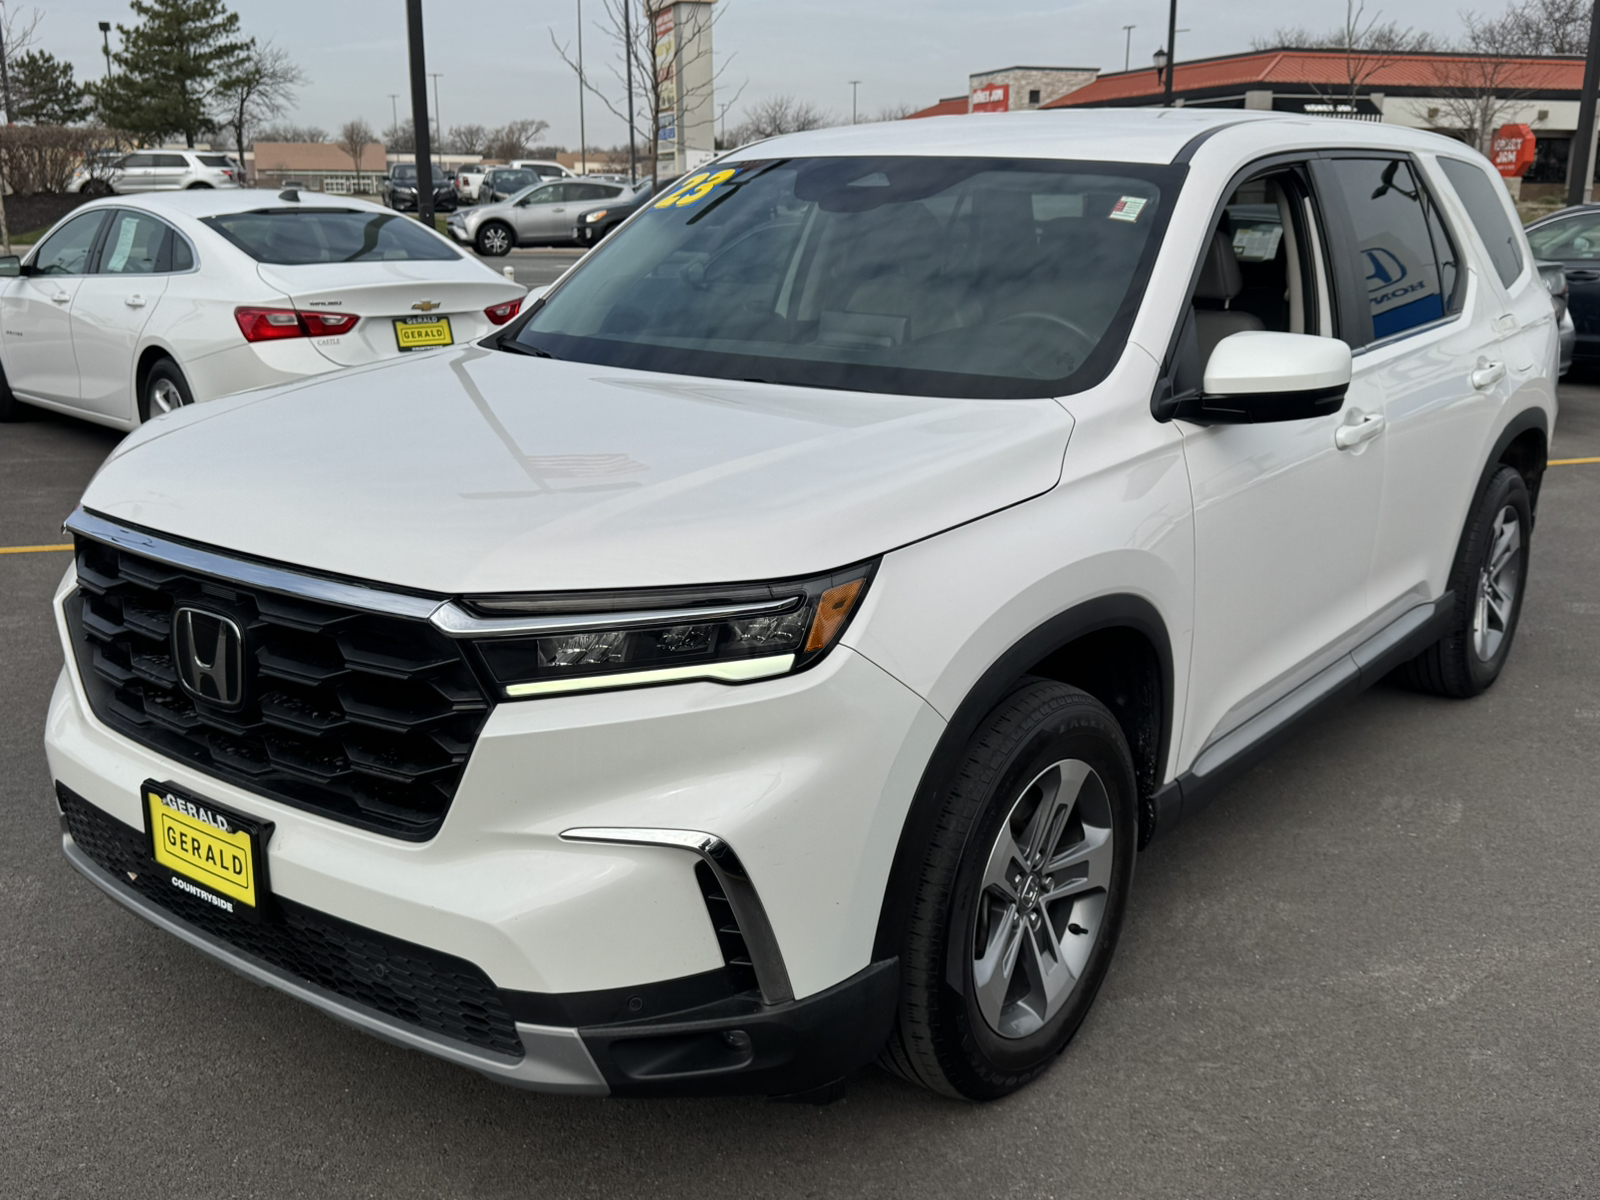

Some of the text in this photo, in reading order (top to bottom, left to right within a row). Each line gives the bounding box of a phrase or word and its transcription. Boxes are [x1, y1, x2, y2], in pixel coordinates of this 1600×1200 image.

[403, 329, 443, 339] GERALD
[406, 316, 438, 324] GERALD
[165, 793, 229, 831] GERALD
[166, 825, 243, 876] GERALD
[171, 876, 234, 913] COUNTRYSIDE
